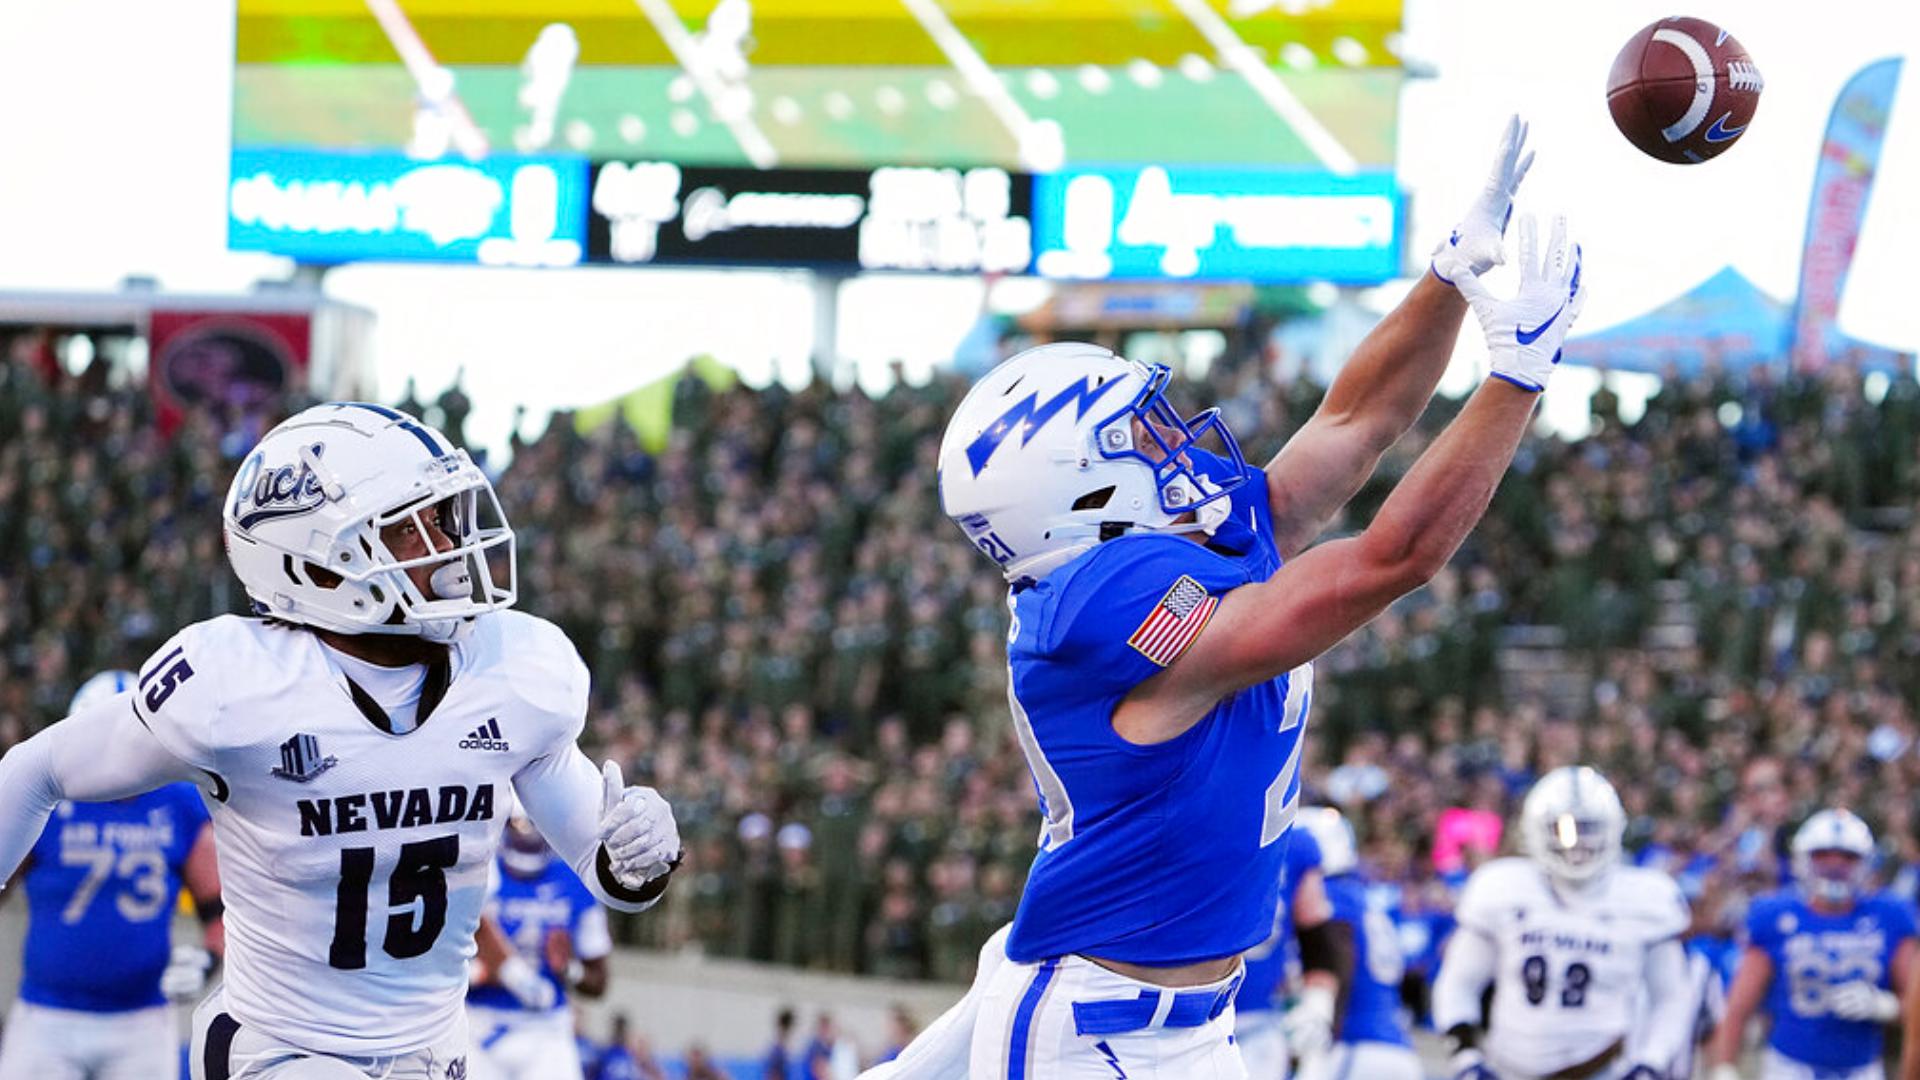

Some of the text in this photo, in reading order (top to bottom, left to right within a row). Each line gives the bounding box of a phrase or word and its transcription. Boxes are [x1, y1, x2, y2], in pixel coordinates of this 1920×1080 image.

[977, 531, 1017, 565] 21
[139, 646, 194, 713] 15
[459, 738, 509, 752] adidas
[297, 784, 494, 836] NEVADA
[61, 848, 167, 924] 73
[329, 833, 459, 970] 15
